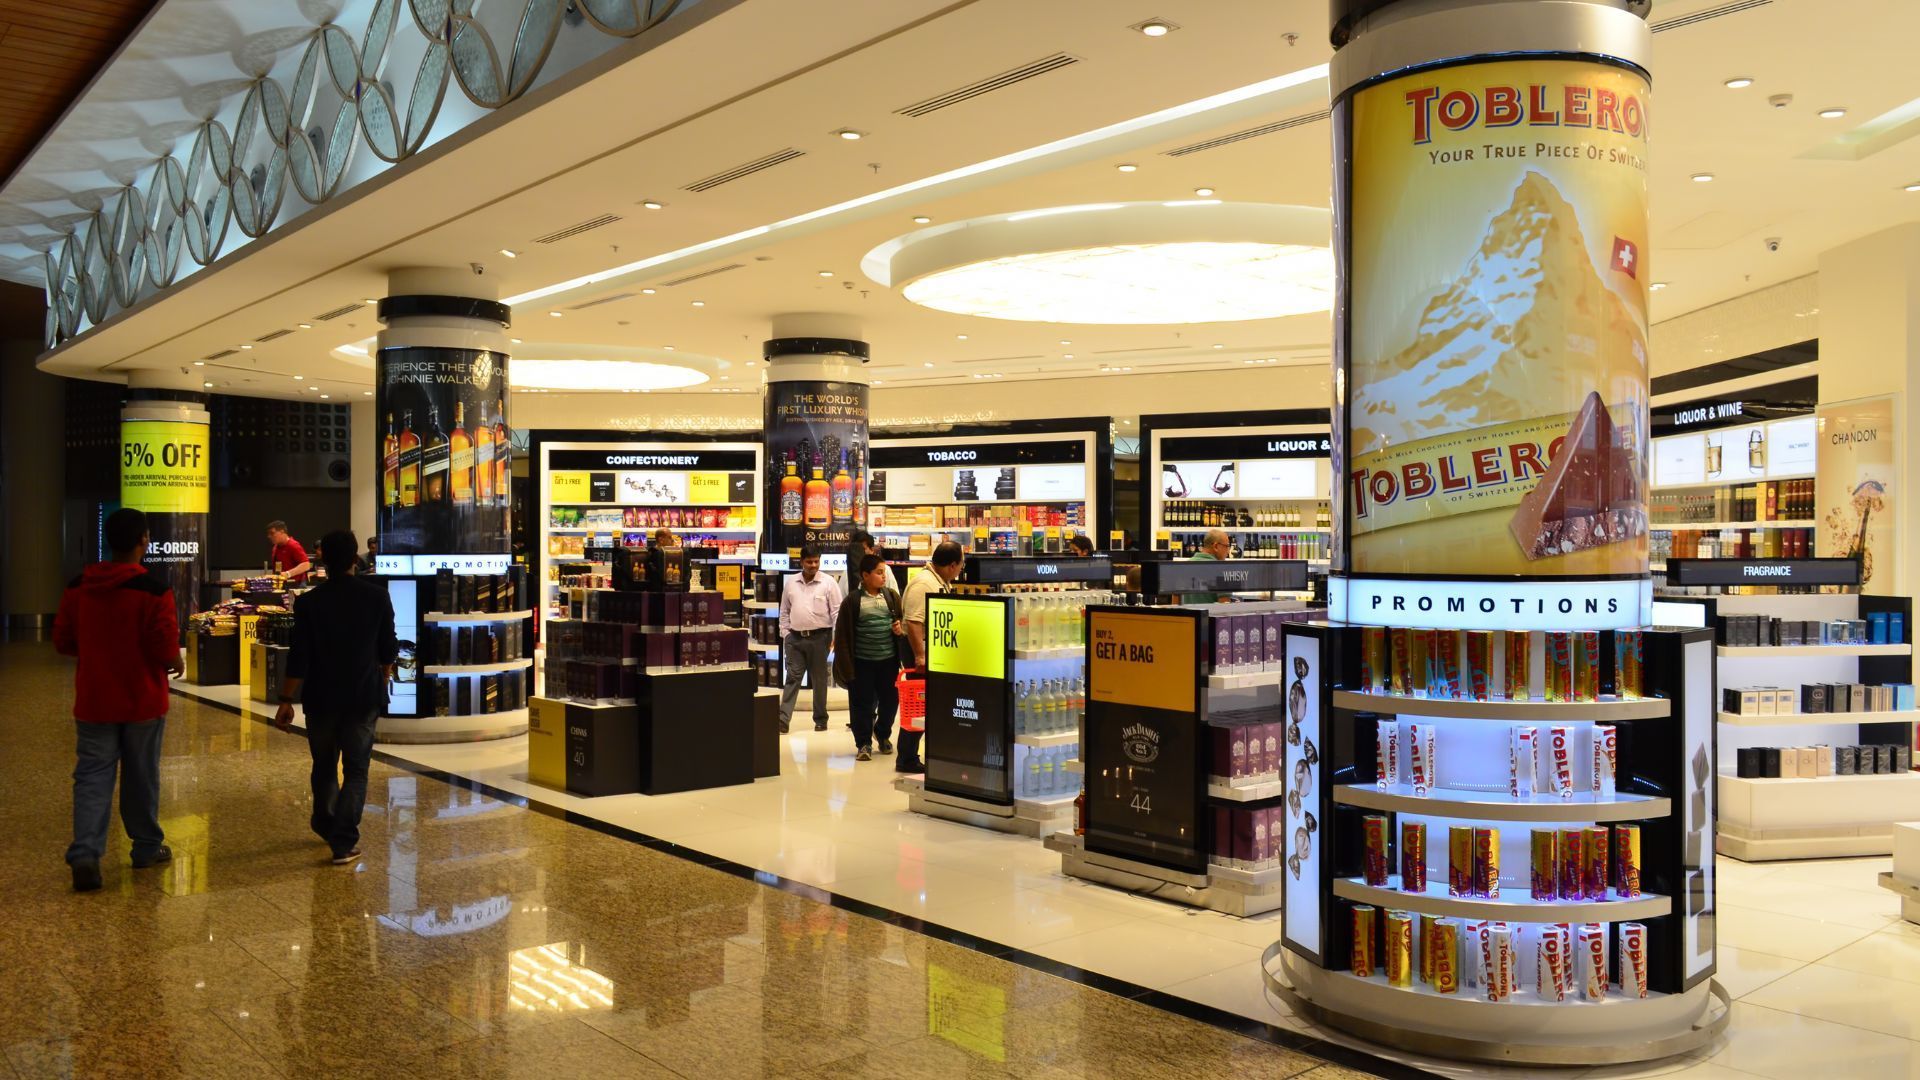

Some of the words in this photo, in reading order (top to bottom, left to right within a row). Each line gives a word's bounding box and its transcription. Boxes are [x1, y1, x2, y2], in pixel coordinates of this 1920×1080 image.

[1405, 85, 1648, 145] TOBLERO
[438, 362, 465, 373] THE
[794, 394, 814, 404] THE
[817, 394, 859, 405] WORLD'S
[777, 405, 801, 415] FIRST
[803, 405, 842, 415] LUXURY
[1674, 408, 1706, 425] LIQUOR
[1708, 406, 1716, 419] &
[1717, 401, 1743, 418] WINE
[1831, 429, 1877, 446] CHANDON
[1267, 440, 1317, 452] LIQUOR
[1321, 440, 1330, 450] &
[124, 442, 154, 468] 5%
[161, 442, 202, 468] OFF
[606, 455, 699, 465] CONFECTIONERY
[927, 450, 977, 462] TOBACCO
[818, 532, 850, 540] CHIVAS
[1036, 564, 1058, 575] VODKA
[1743, 565, 1791, 576] FRAGRANCE
[1223, 570, 1249, 582] WHISKY
[1371, 594, 1618, 614] PROMOTIONS
[244, 621, 256, 630] TO
[933, 610, 954, 629] TOP
[933, 629, 959, 648] PICK
[1095, 629, 1107, 639] BUY
[1095, 641, 1116, 660] GET
[1119, 643, 1127, 661] A
[1130, 644, 1154, 664] BAG
[956, 697, 975, 709] LIQUOR
[952, 708, 979, 720] SELECTION
[573, 751, 585, 767] 40
[1130, 793, 1153, 815] 44
